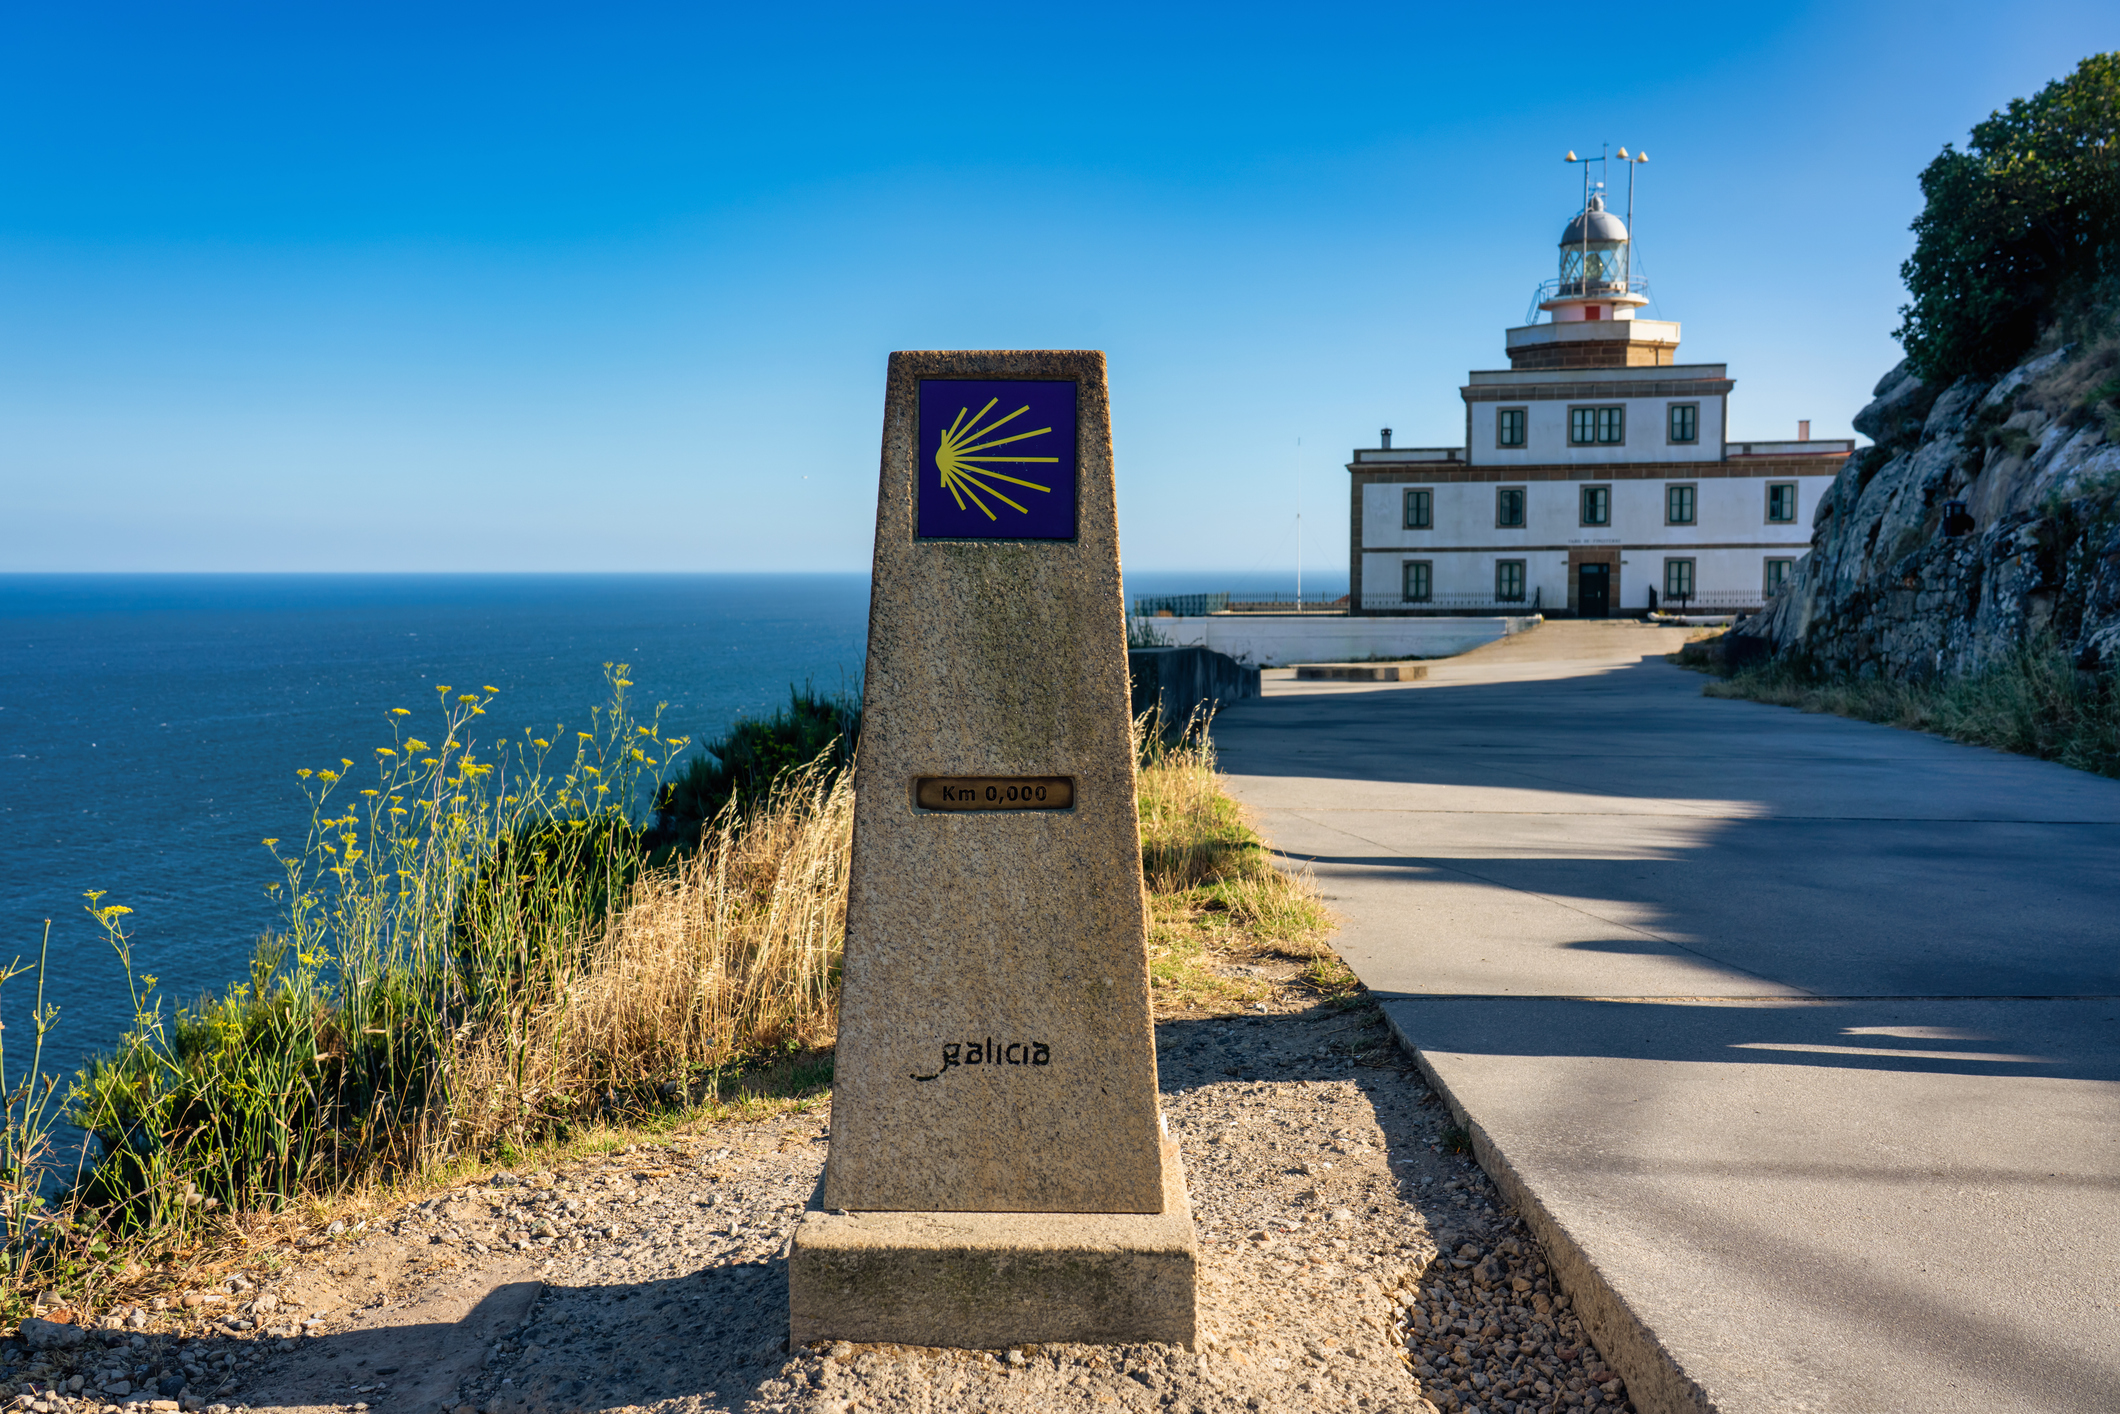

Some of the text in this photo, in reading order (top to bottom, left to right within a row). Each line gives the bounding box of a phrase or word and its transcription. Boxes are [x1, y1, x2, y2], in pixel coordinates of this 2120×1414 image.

[942, 785, 1047, 805] Km 0,000
[909, 1036, 1050, 1082] galicia
